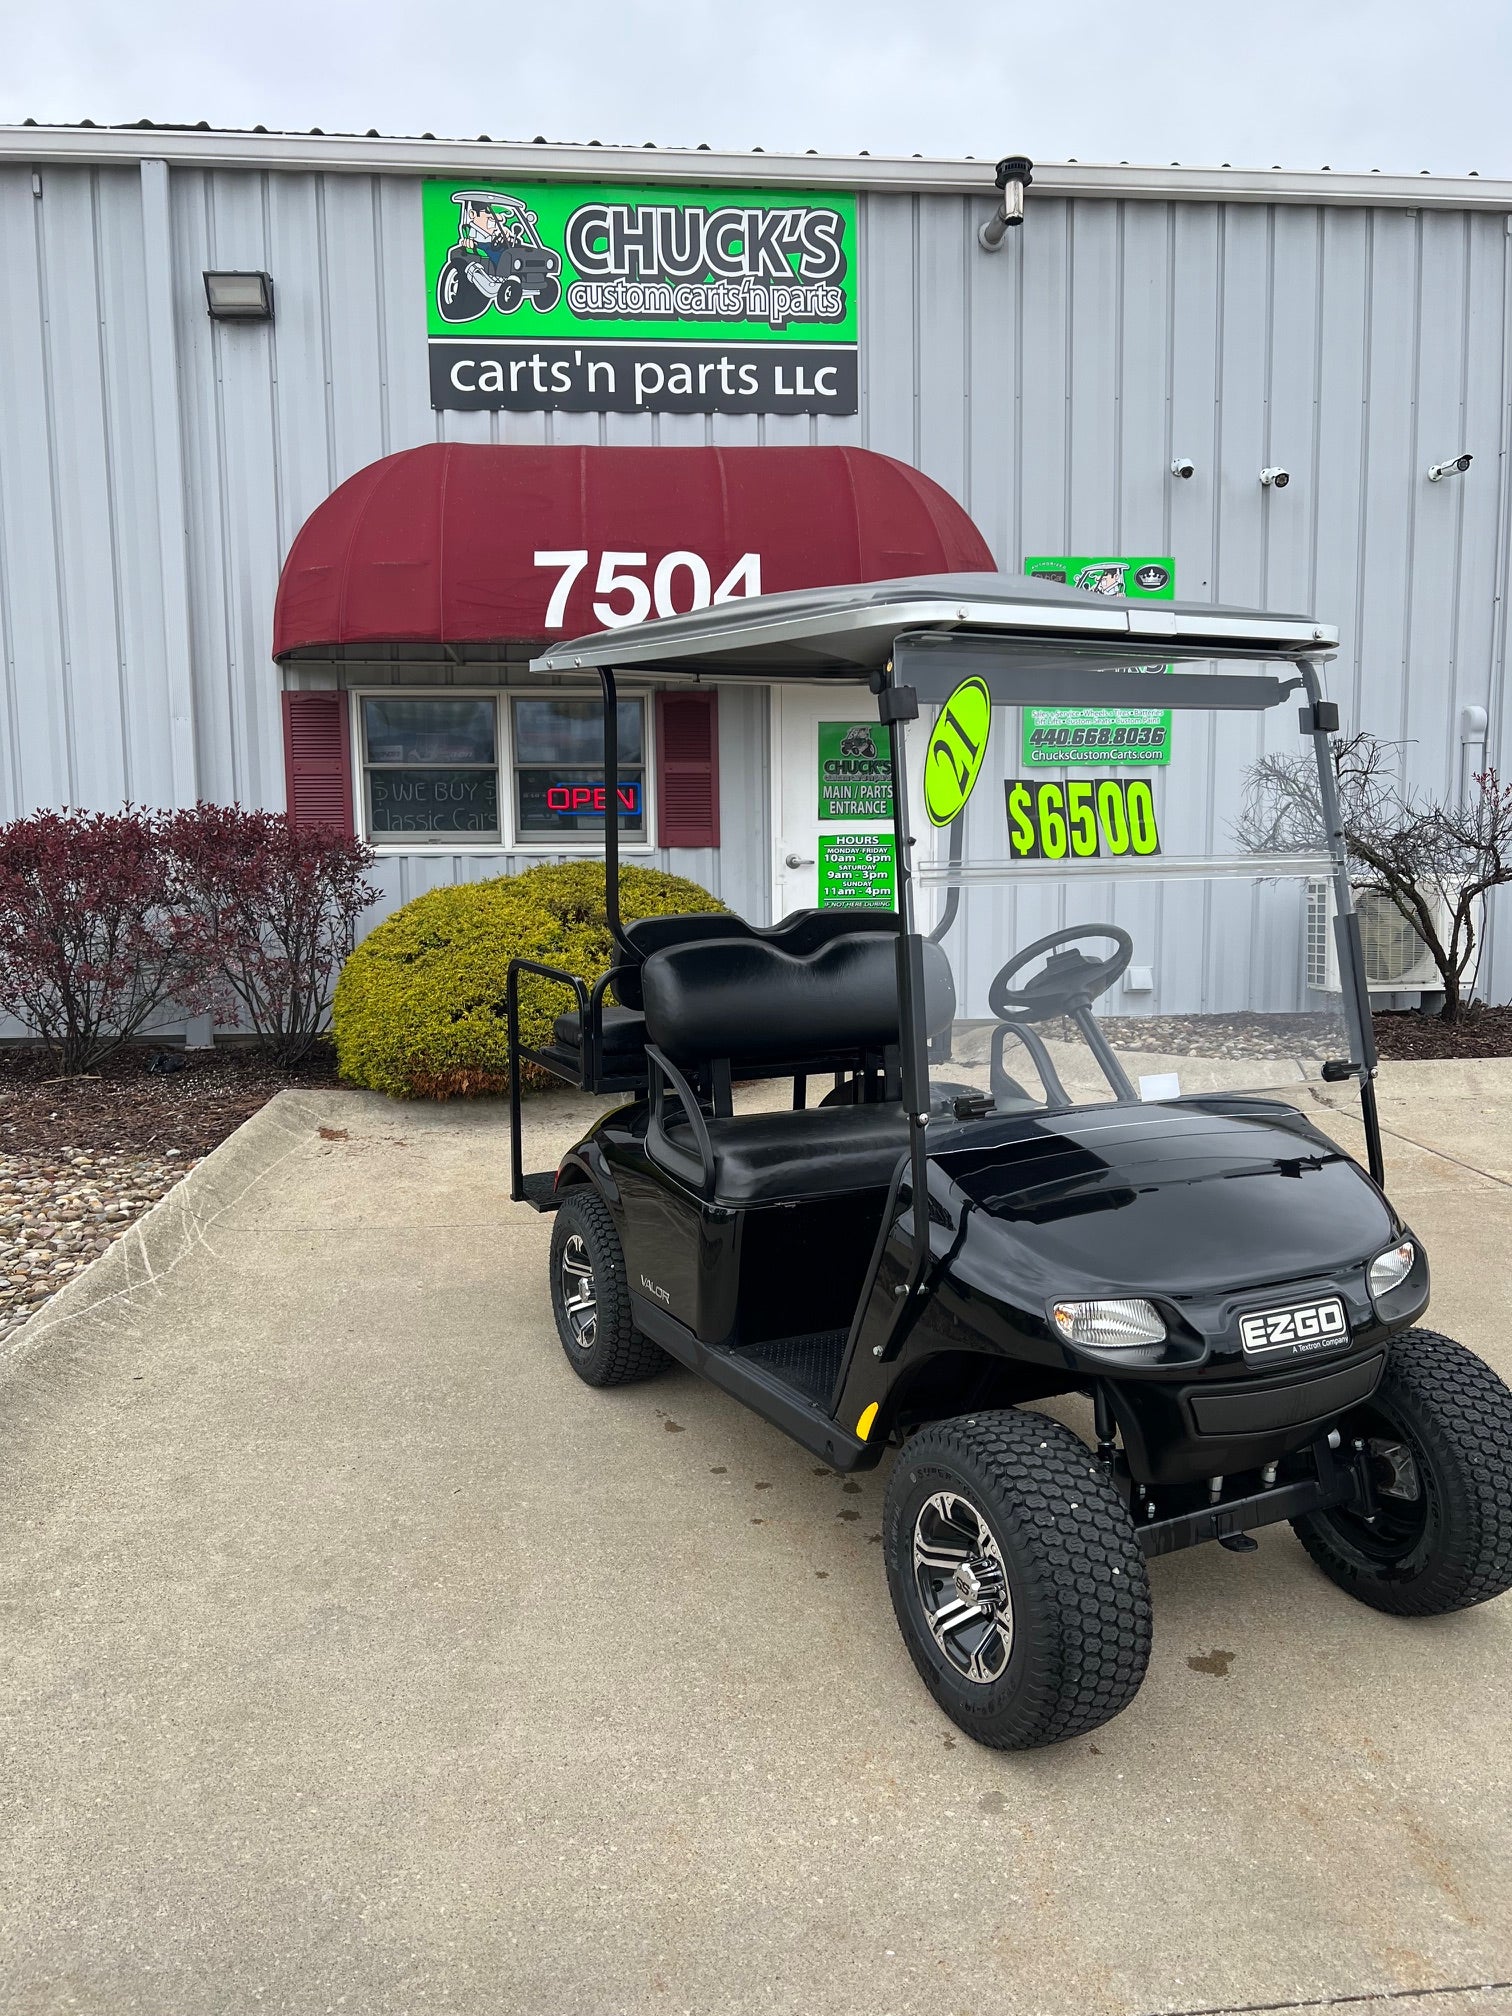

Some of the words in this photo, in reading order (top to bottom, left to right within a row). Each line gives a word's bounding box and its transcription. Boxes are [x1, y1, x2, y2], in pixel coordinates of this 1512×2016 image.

[566, 203, 844, 282] CHUCK'S
[568, 280, 673, 315] custom
[769, 281, 843, 324] parts
[450, 350, 616, 393] carts'n
[635, 356, 760, 405] parts
[774, 366, 838, 396] LLC
[1031, 561, 1067, 570] AUTHORIZED
[533, 550, 762, 629] 7504
[1032, 710, 1050, 718] Sales
[1055, 709, 1080, 717] Service
[1083, 709, 1109, 717] Wheels
[1114, 708, 1131, 717] Tires
[1134, 708, 1164, 717] Batteries
[1065, 717, 1091, 725] Custom
[1093, 717, 1111, 725] Seats
[1142, 716, 1161, 724] Paint
[1029, 726, 1168, 747] 440.668.8036
[933, 707, 981, 797] 21
[1031, 749, 1163, 762] ChucksCustomCarts.com
[824, 759, 892, 775] CHUCK'S
[392, 782, 427, 802] WE
[434, 782, 479, 802] BUY
[546, 787, 636, 811] OPEN
[823, 785, 852, 799] MAIN
[860, 785, 894, 799] PARTS
[829, 800, 887, 814] ENTRANCE
[372, 808, 445, 832] Classic
[452, 807, 497, 832] Cars
[1008, 781, 1158, 860] $6500
[836, 836, 879, 845] HOURS
[825, 853, 856, 862] 10am
[865, 853, 892, 864] 6pm
[827, 870, 853, 879] 9am
[862, 870, 888, 881] 3pm
[824, 887, 856, 895] 11am
[865, 887, 891, 897] 4pm
[640, 1274, 670, 1305] VALOR
[1292, 1345, 1298, 1354] A
[1297, 1341, 1322, 1352] Textron
[1321, 1336, 1350, 1348] Company
[955, 1575, 971, 1596] SS
